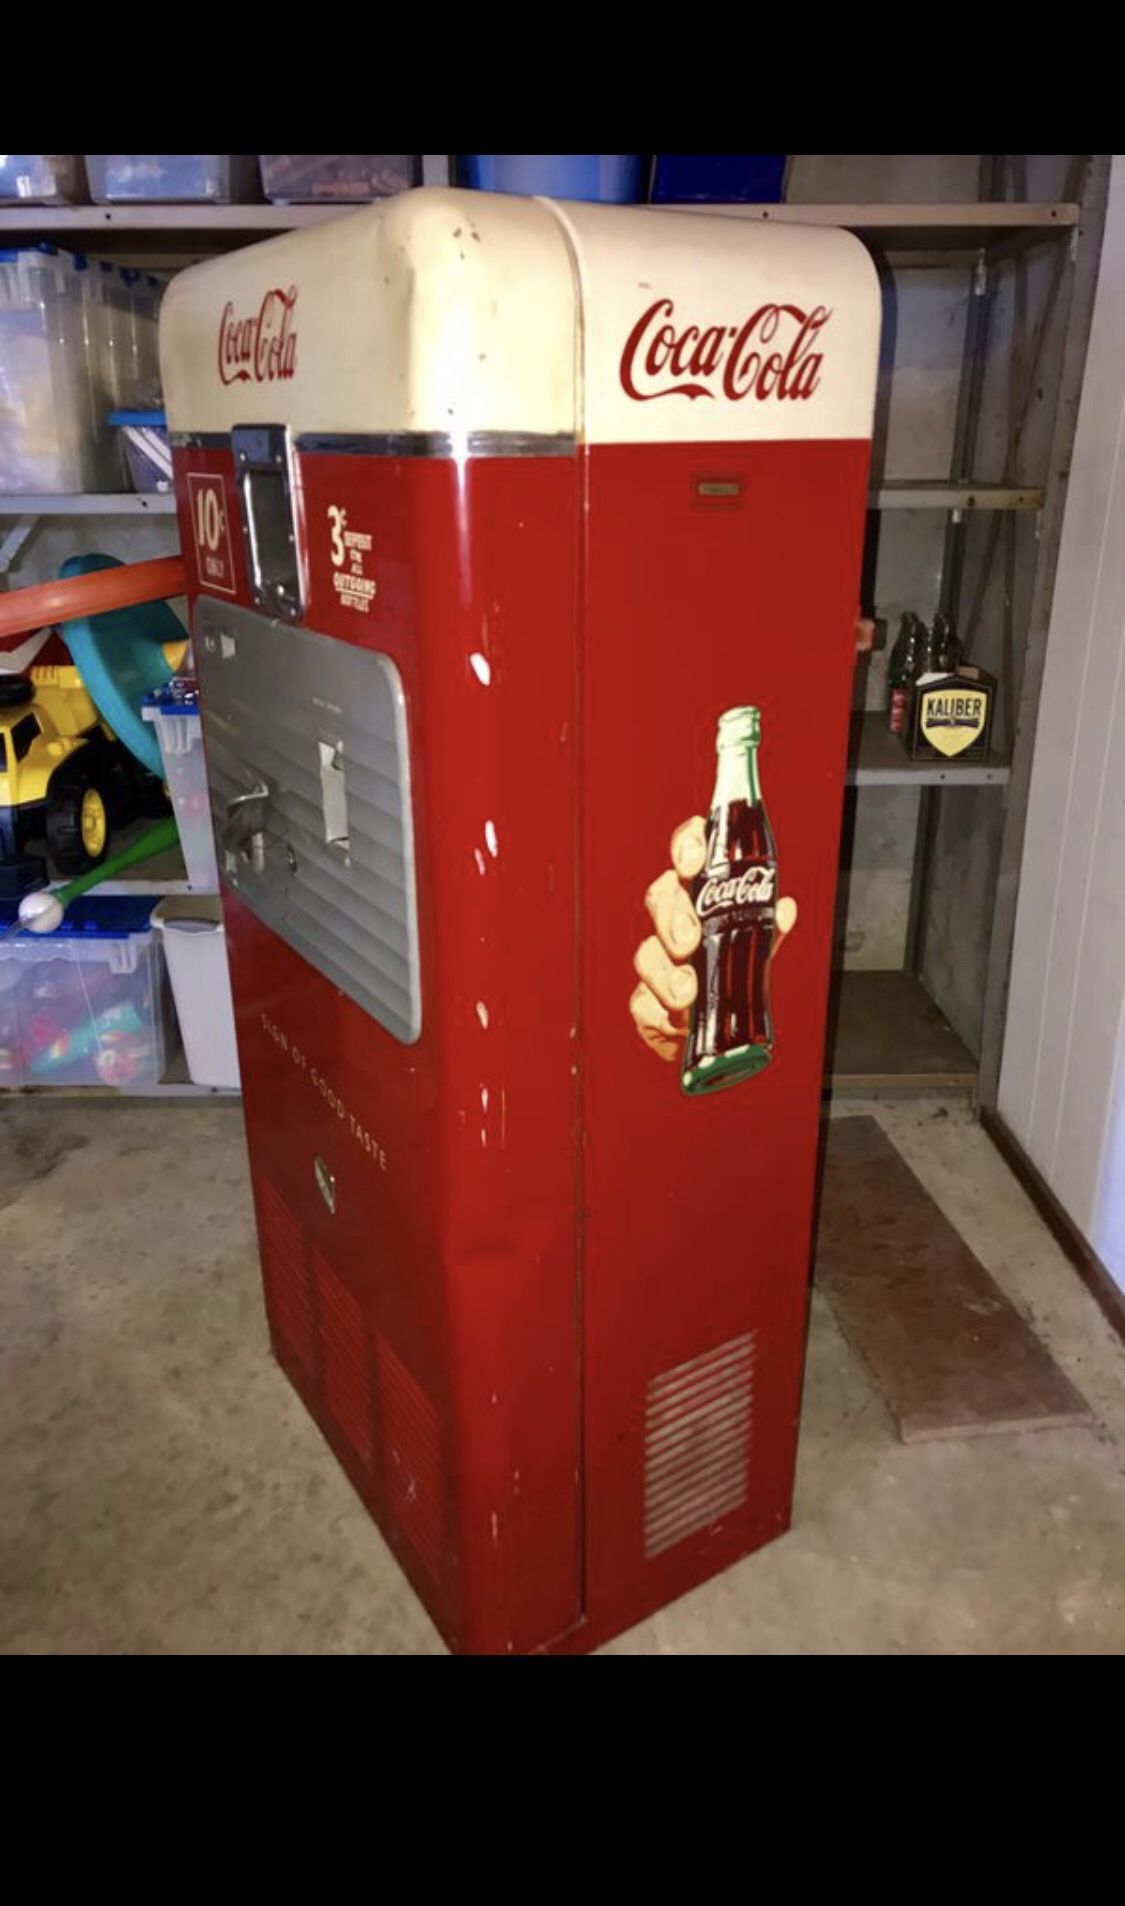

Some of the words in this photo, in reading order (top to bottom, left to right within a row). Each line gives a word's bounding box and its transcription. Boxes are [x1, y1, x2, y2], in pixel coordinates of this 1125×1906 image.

[619, 298, 833, 401] Coca-Cola
[927, 698, 981, 717] KALIBER
[261, 1013, 288, 1050] SIGN
[292, 1045, 306, 1070] OF
[311, 1067, 345, 1119] GOOD
[350, 1114, 386, 1172] TASTE
